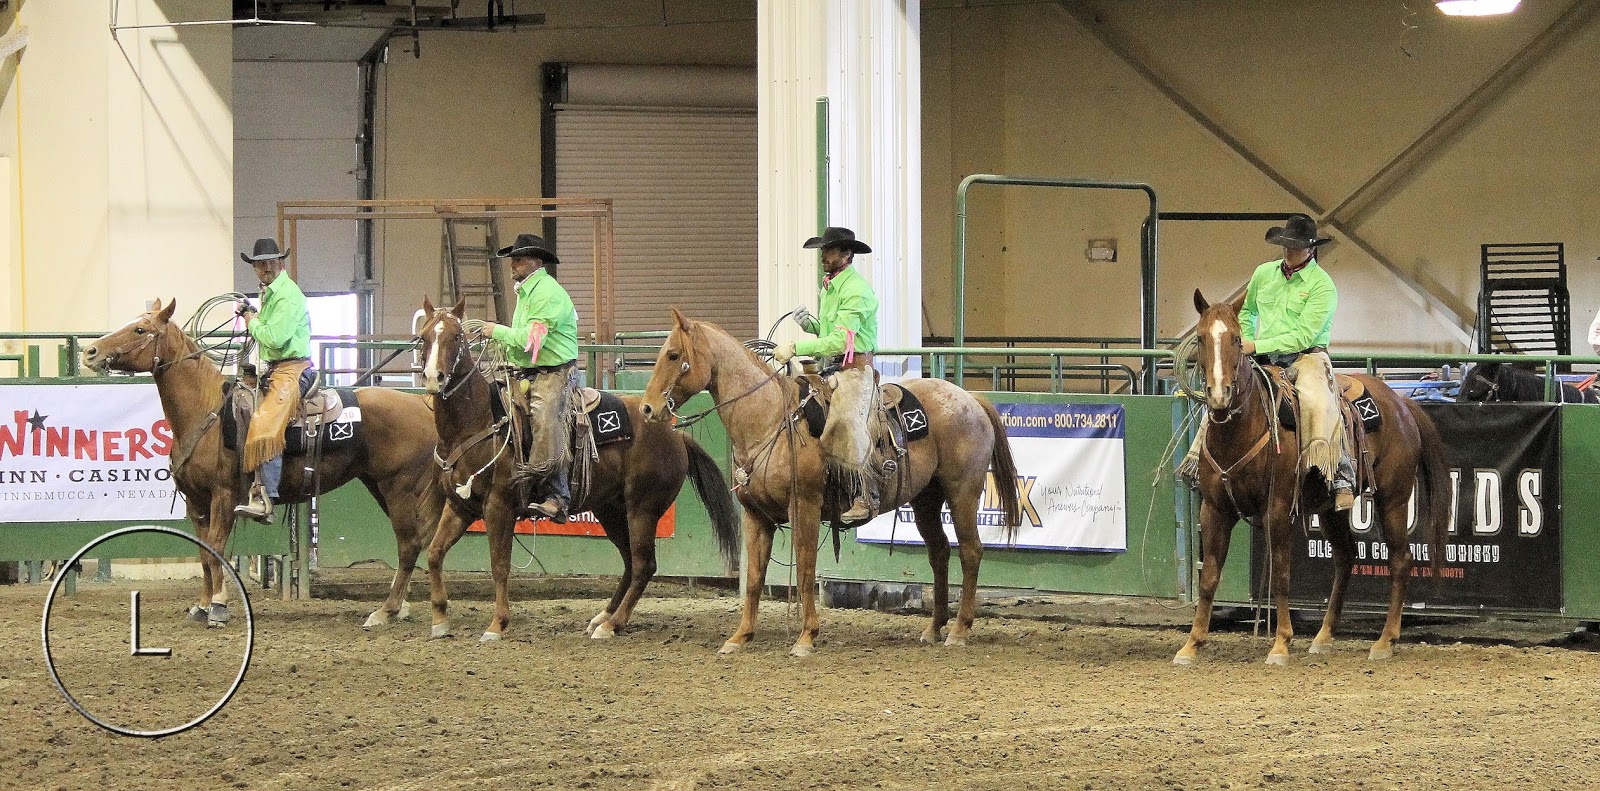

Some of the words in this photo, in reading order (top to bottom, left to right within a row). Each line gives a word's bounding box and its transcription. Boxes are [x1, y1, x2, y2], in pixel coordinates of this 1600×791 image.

[1000, 412, 1047, 427] ition.com
[1054, 412, 1117, 428] 800.734.2811
[0, 410, 173, 461] WINNERS
[0, 470, 47, 483] INN
[69, 468, 171, 482] CASINO
[0, 491, 95, 501] INNEMUCCA
[117, 489, 176, 499] NEVADA
[1445, 544, 1499, 562] WHISKY
